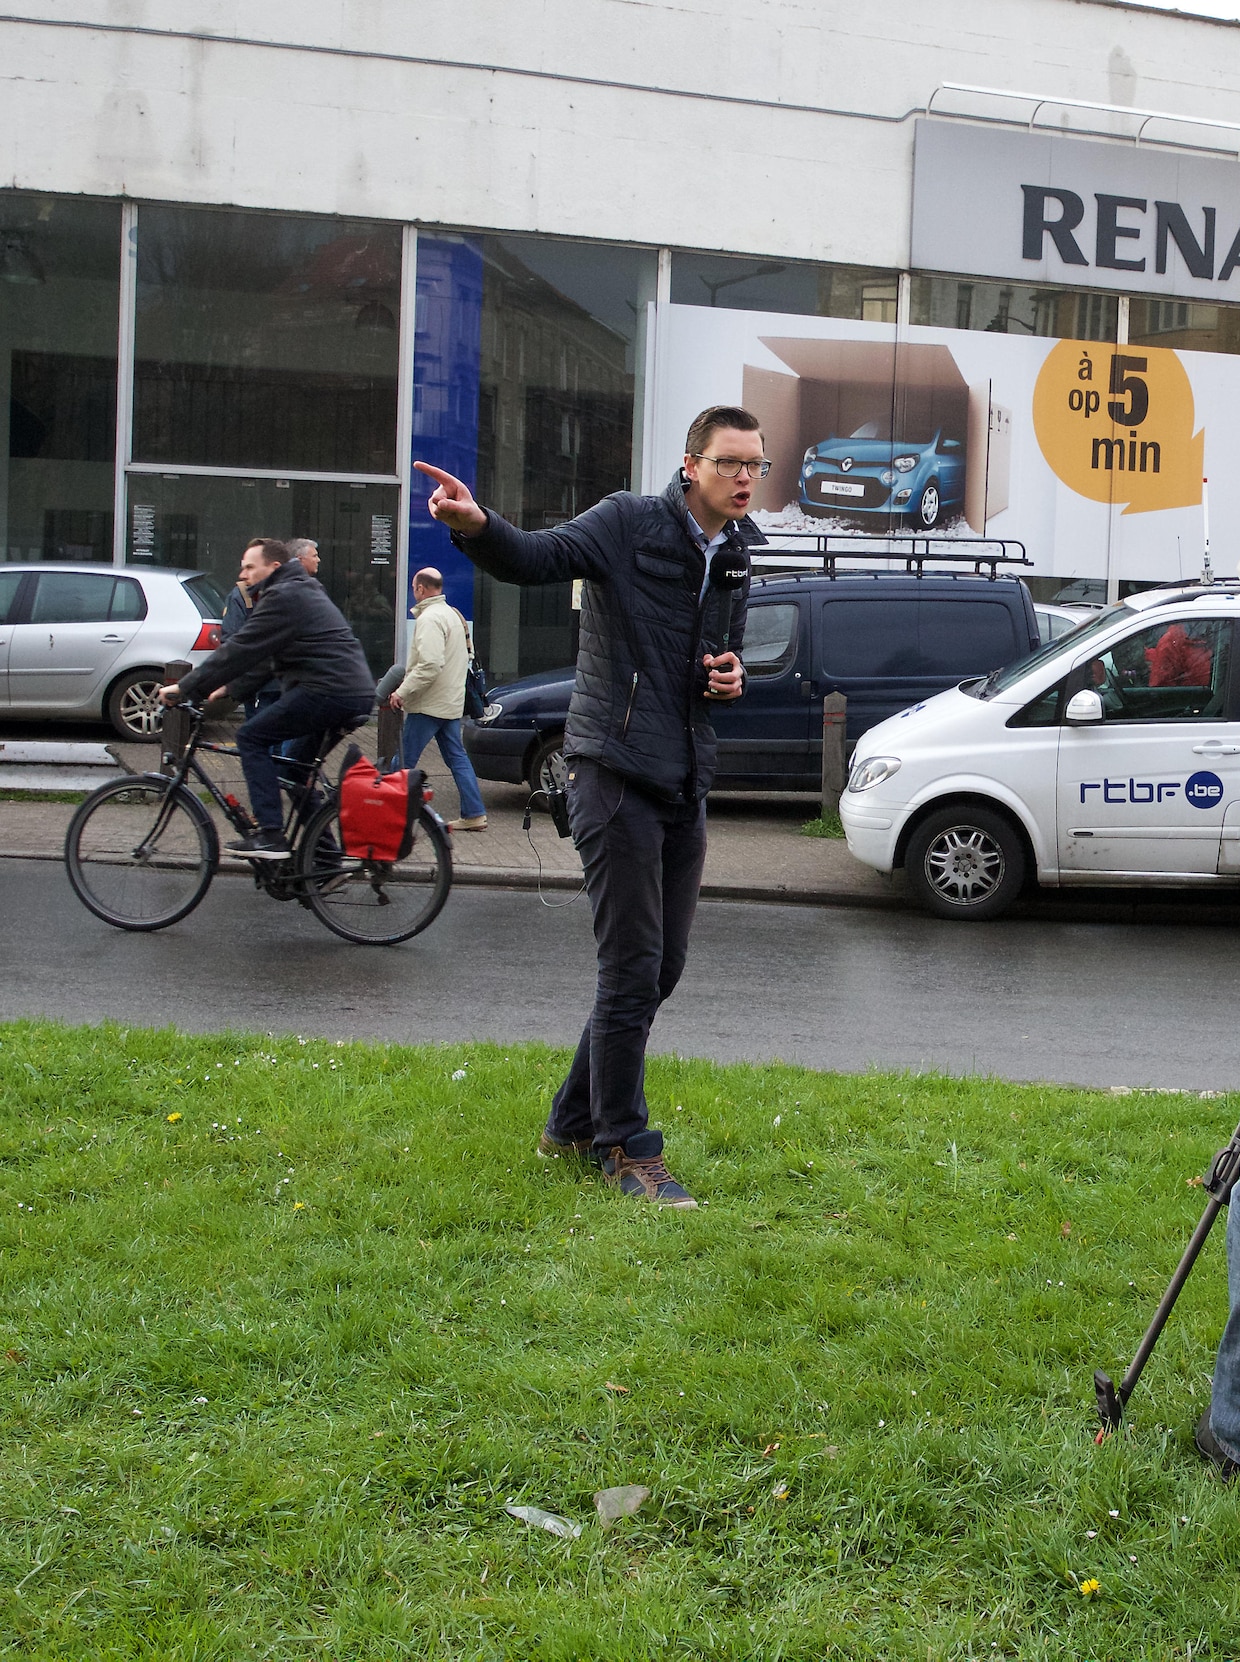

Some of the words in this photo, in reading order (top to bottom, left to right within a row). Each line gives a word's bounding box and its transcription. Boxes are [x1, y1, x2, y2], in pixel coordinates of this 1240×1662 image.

[1078, 351, 1093, 381] à
[1068, 388, 1100, 419] op
[1107, 354, 1150, 427] 5
[1091, 430, 1161, 473] min
[831, 485, 853, 493] TWINGO
